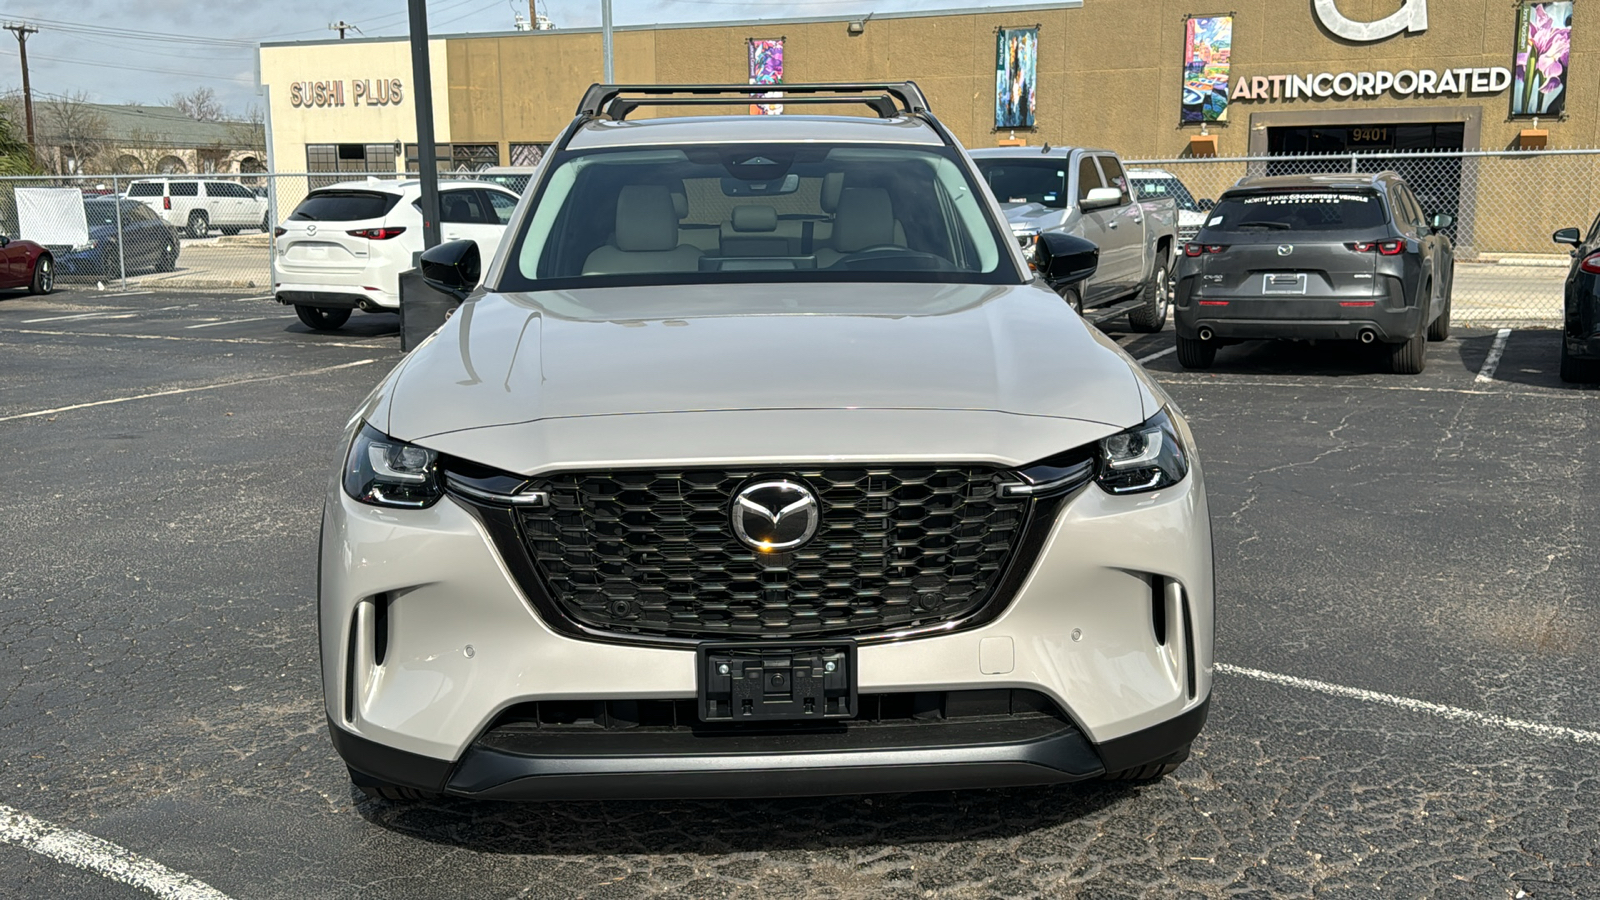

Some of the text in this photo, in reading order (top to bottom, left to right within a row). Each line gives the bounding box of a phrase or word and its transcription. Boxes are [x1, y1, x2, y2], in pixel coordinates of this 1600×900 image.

[290, 79, 403, 108] SUSHI PLUS
[1231, 67, 1512, 99] ARTINCORPORATED
[1352, 127, 1388, 142] 9401
[1339, 194, 1369, 203] VEHICLE
